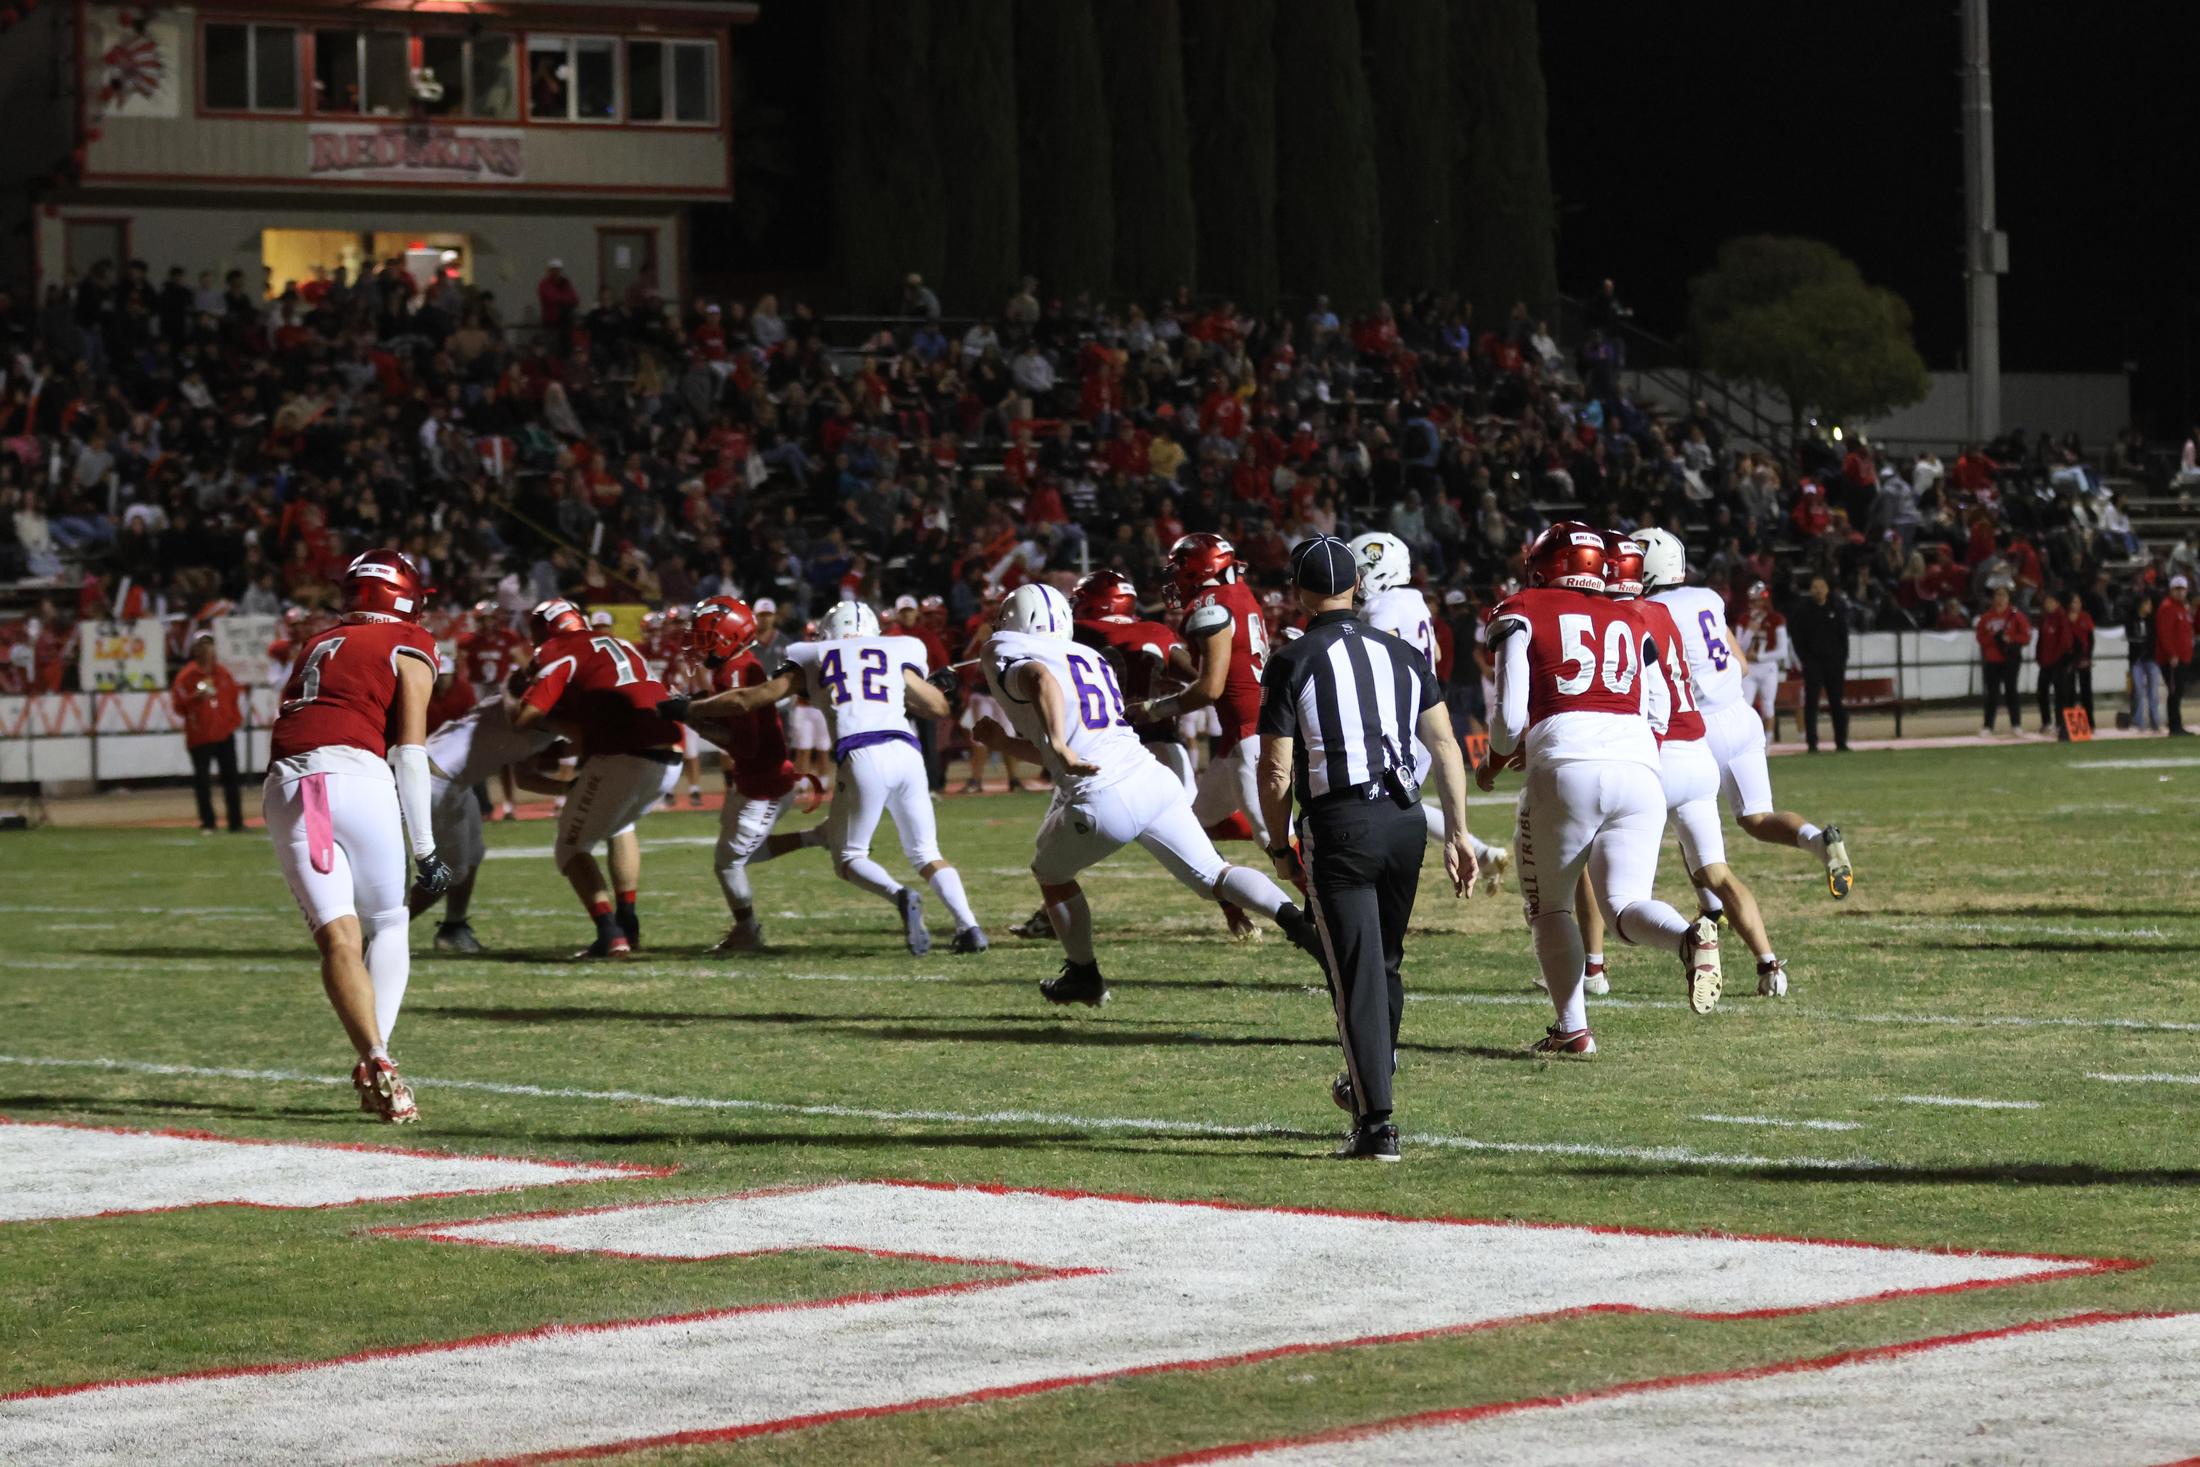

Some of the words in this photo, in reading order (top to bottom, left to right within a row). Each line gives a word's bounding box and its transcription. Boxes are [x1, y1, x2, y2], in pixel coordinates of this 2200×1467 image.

[1566, 577, 1602, 592] Riddell
[1247, 612, 1272, 685] 5
[1555, 613, 1638, 696] 50
[1698, 609, 1729, 673] 6
[819, 649, 889, 706] 42
[1520, 807, 1536, 866] TRIBE
